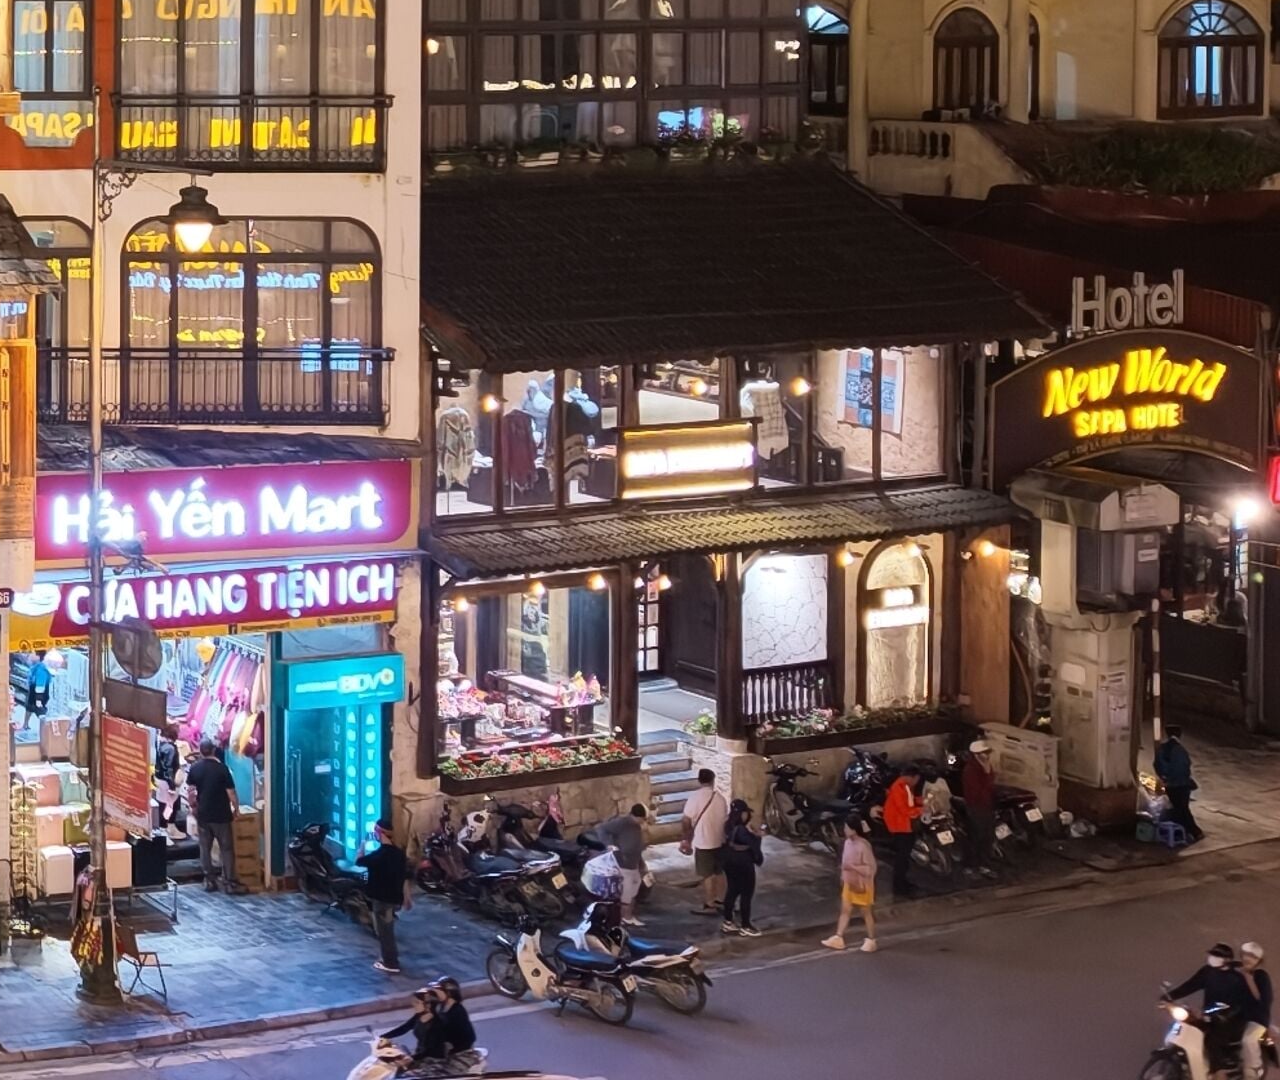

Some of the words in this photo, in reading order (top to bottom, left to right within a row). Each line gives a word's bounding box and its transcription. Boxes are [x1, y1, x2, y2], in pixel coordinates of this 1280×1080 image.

[1072, 269, 1184, 333] Hotel
[1043, 363, 1120, 418] New
[1124, 346, 1226, 401] World
[148, 477, 246, 538] Yến
[259, 482, 383, 535] Mart
